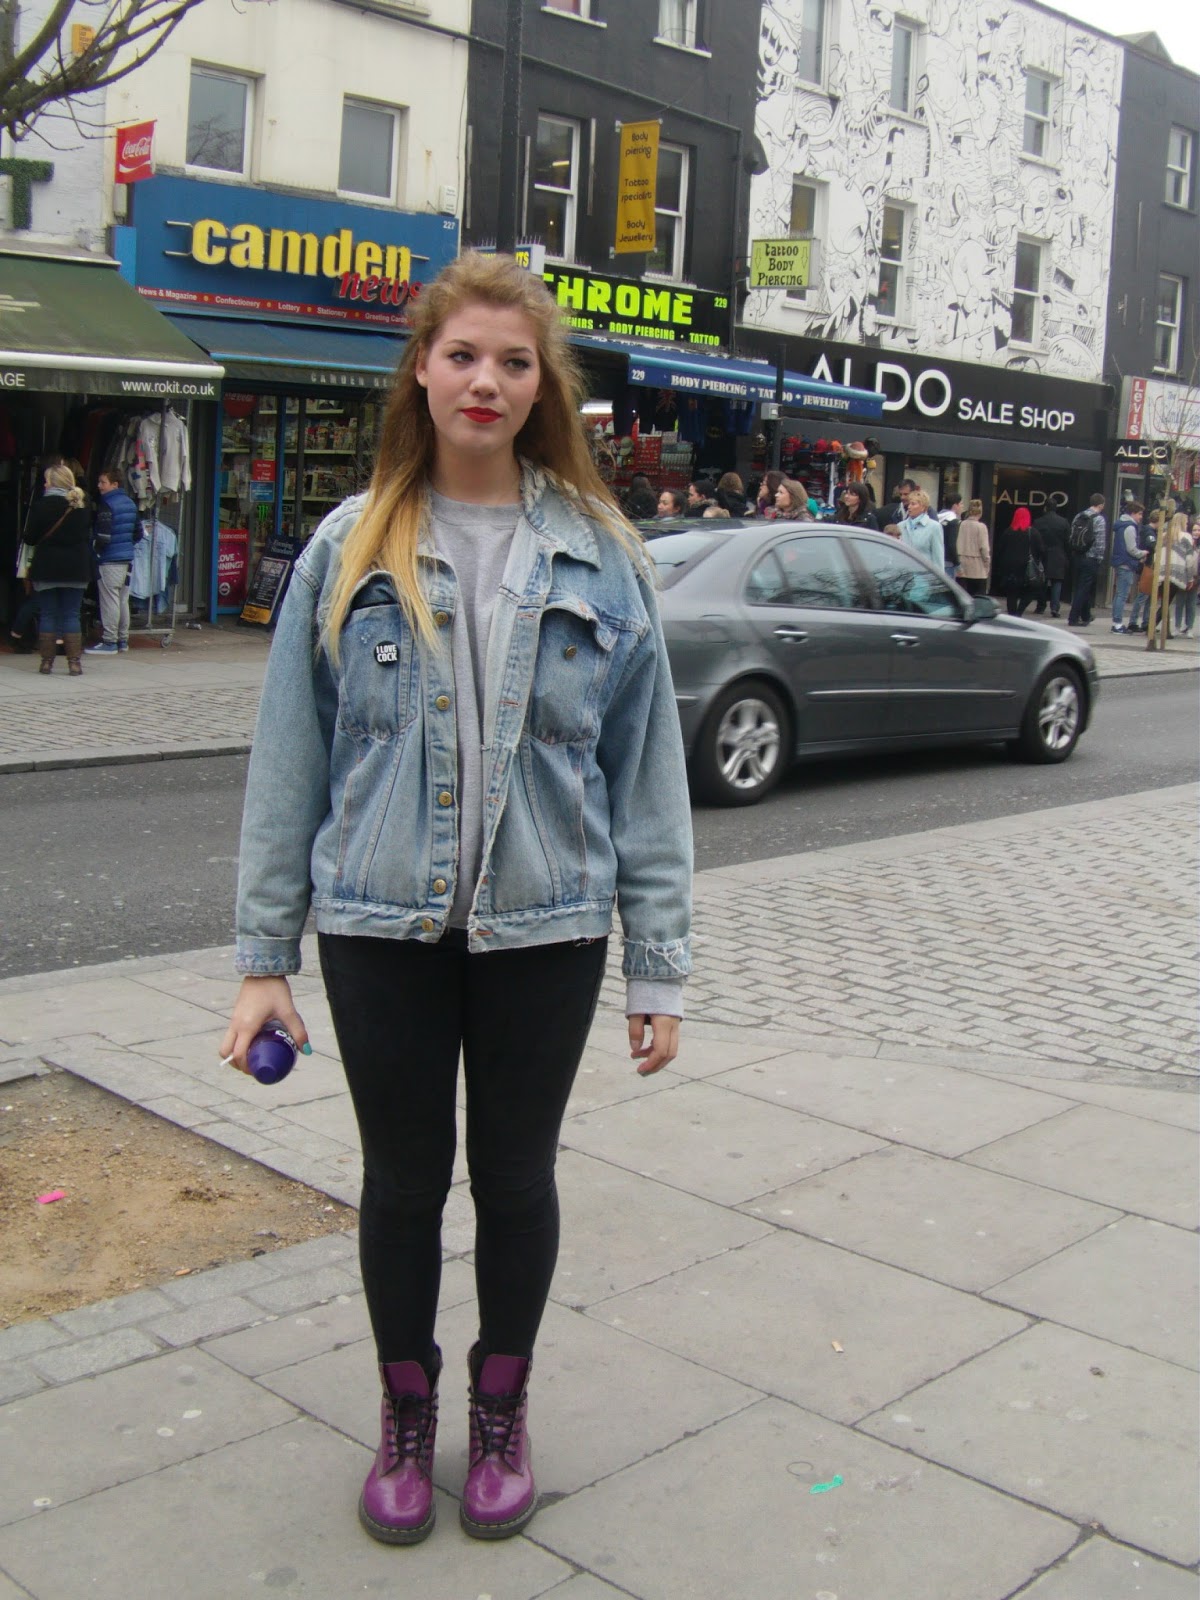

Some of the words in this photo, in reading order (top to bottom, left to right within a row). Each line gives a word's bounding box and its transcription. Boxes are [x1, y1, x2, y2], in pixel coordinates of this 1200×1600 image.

[631, 132, 649, 142] Body
[625, 147, 652, 159] piercing
[443, 221, 455, 230] 227
[192, 218, 411, 286] camden
[138, 287, 157, 297] News
[158, 289, 164, 297] &
[165, 290, 197, 301] Magazine
[215, 296, 260, 308] Confectionery
[278, 302, 300, 313] Lottery
[317, 307, 347, 318] Stationery
[365, 312, 389, 323] Greeting
[543, 272, 693, 326] HROME
[714, 297, 727, 308] 229
[609, 321, 633, 336] BODY
[634, 325, 675, 341] PIERCING
[690, 333, 720, 347] TATTOO
[122, 381, 215, 395] www.rokit.co.uk
[631, 369, 646, 381] 229
[671, 374, 701, 388] BODY
[701, 379, 747, 396] PIERCING
[757, 387, 793, 402] TATOO
[803, 394, 850, 410] JEWELLERY
[958, 399, 1014, 425] SALE
[1019, 406, 1075, 432] SHOP
[1114, 445, 1168, 459] ALDO
[376, 645, 380, 654] I
[380, 644, 397, 654] LOVE
[377, 653, 398, 663] COCK
